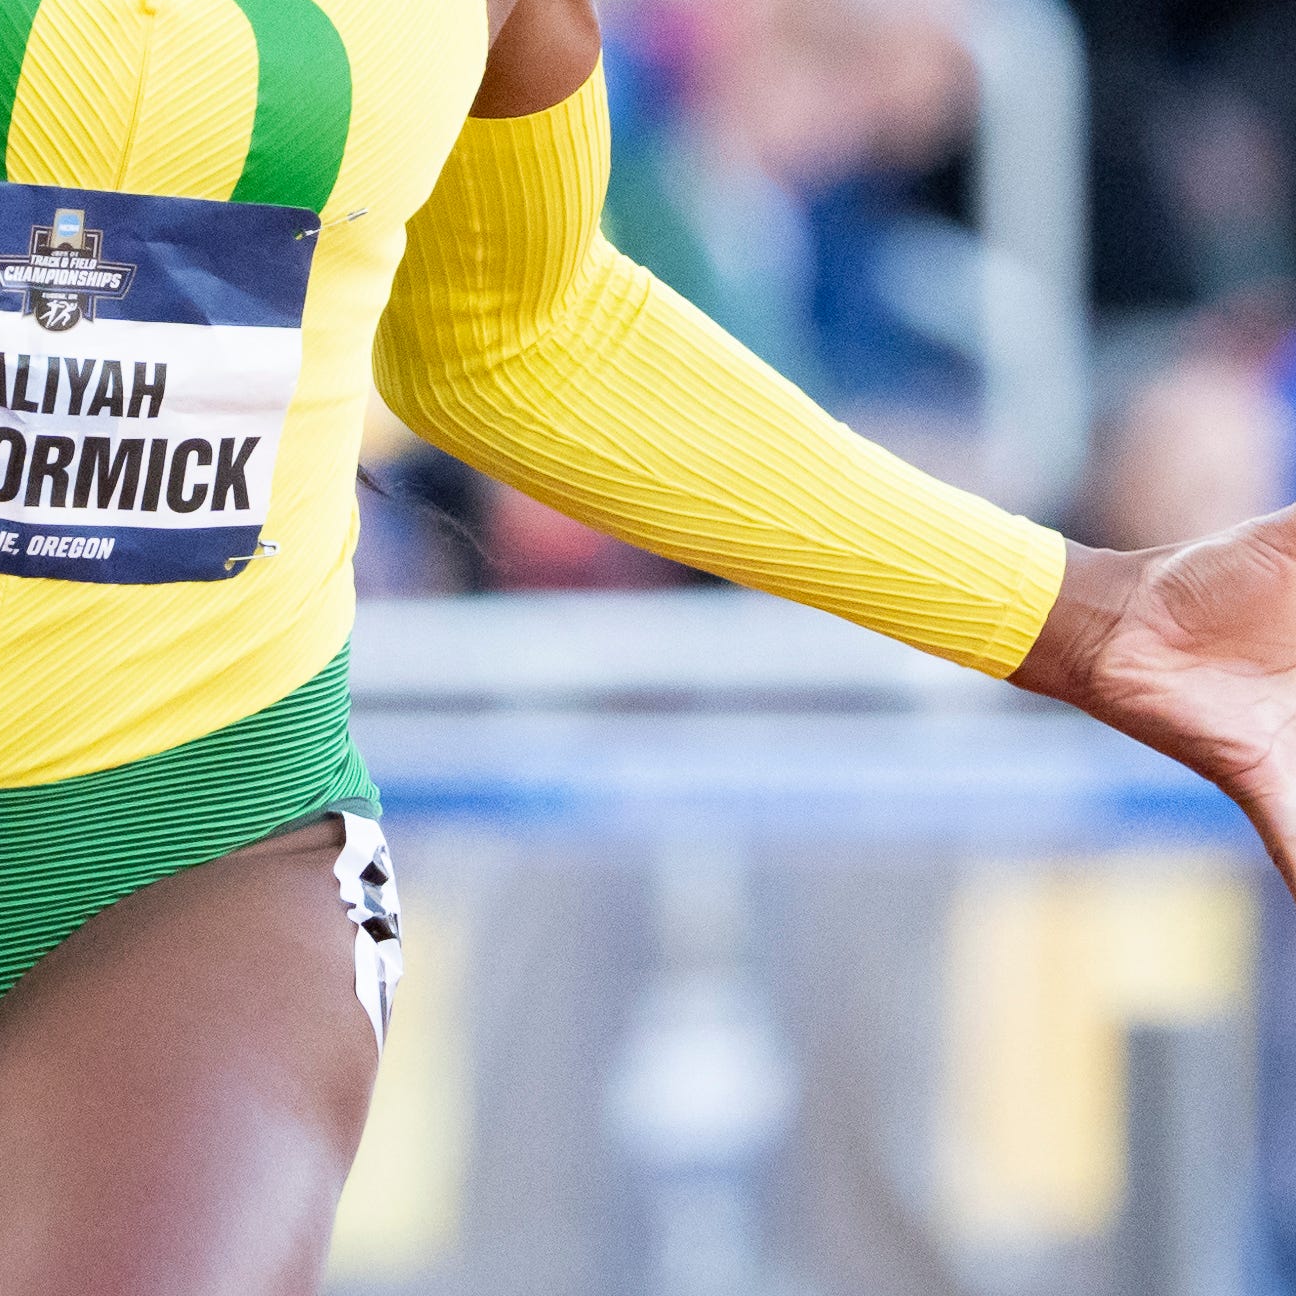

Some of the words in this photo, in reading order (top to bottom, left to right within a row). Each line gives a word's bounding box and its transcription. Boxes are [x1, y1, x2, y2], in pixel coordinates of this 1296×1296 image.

[30, 255, 62, 268] TRACK
[70, 257, 97, 270] FIELD
[4, 265, 122, 289] CHAMPIONSHIPS
[26, 535, 115, 560] OREGON
